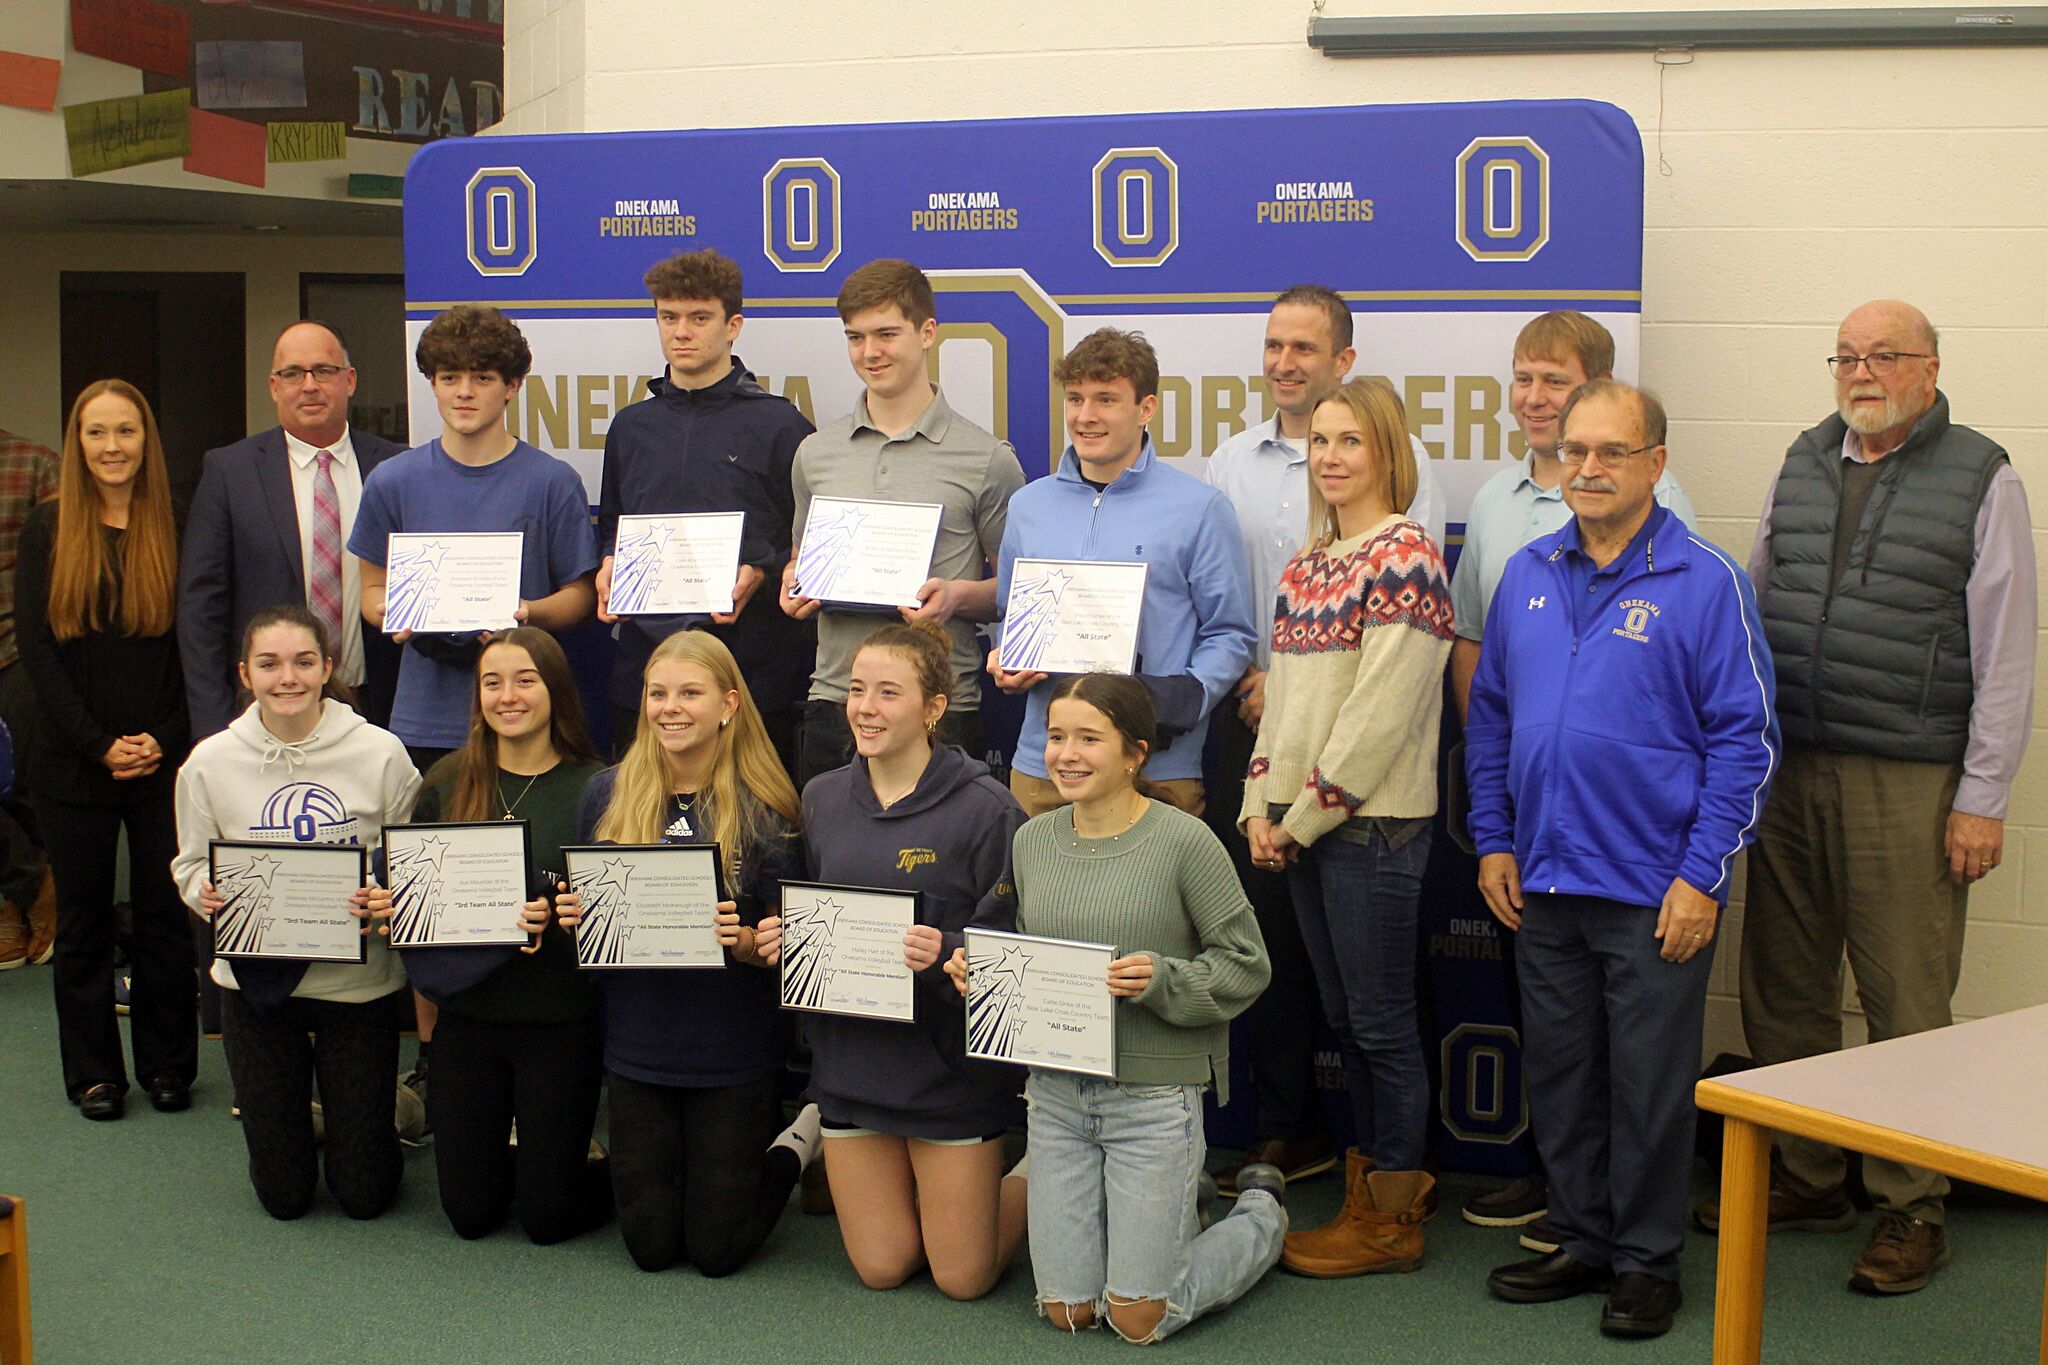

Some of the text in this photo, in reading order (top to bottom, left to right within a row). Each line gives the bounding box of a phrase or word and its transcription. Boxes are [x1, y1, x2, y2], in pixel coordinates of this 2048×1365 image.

[271, 123, 340, 161] KRYPTON
[928, 192, 1000, 210] ONEKAMA
[1275, 181, 1354, 200] ONEKAMA
[1455, 136, 1549, 262] O
[615, 199, 679, 216] ONEKAMA
[763, 157, 841, 272] O
[1092, 146, 1179, 267] O
[1256, 199, 1374, 224] PORTAGERS
[465, 166, 537, 277] O
[600, 215, 696, 238] PORTAGERS
[911, 208, 1018, 232] PORTAGERS
[1618, 599, 1661, 618] ONEKAMA
[1624, 607, 1648, 633] O
[665, 828, 693, 837] adidas
[896, 849, 936, 873] Tigers
[1047, 1022, 1086, 1033] "All State"
